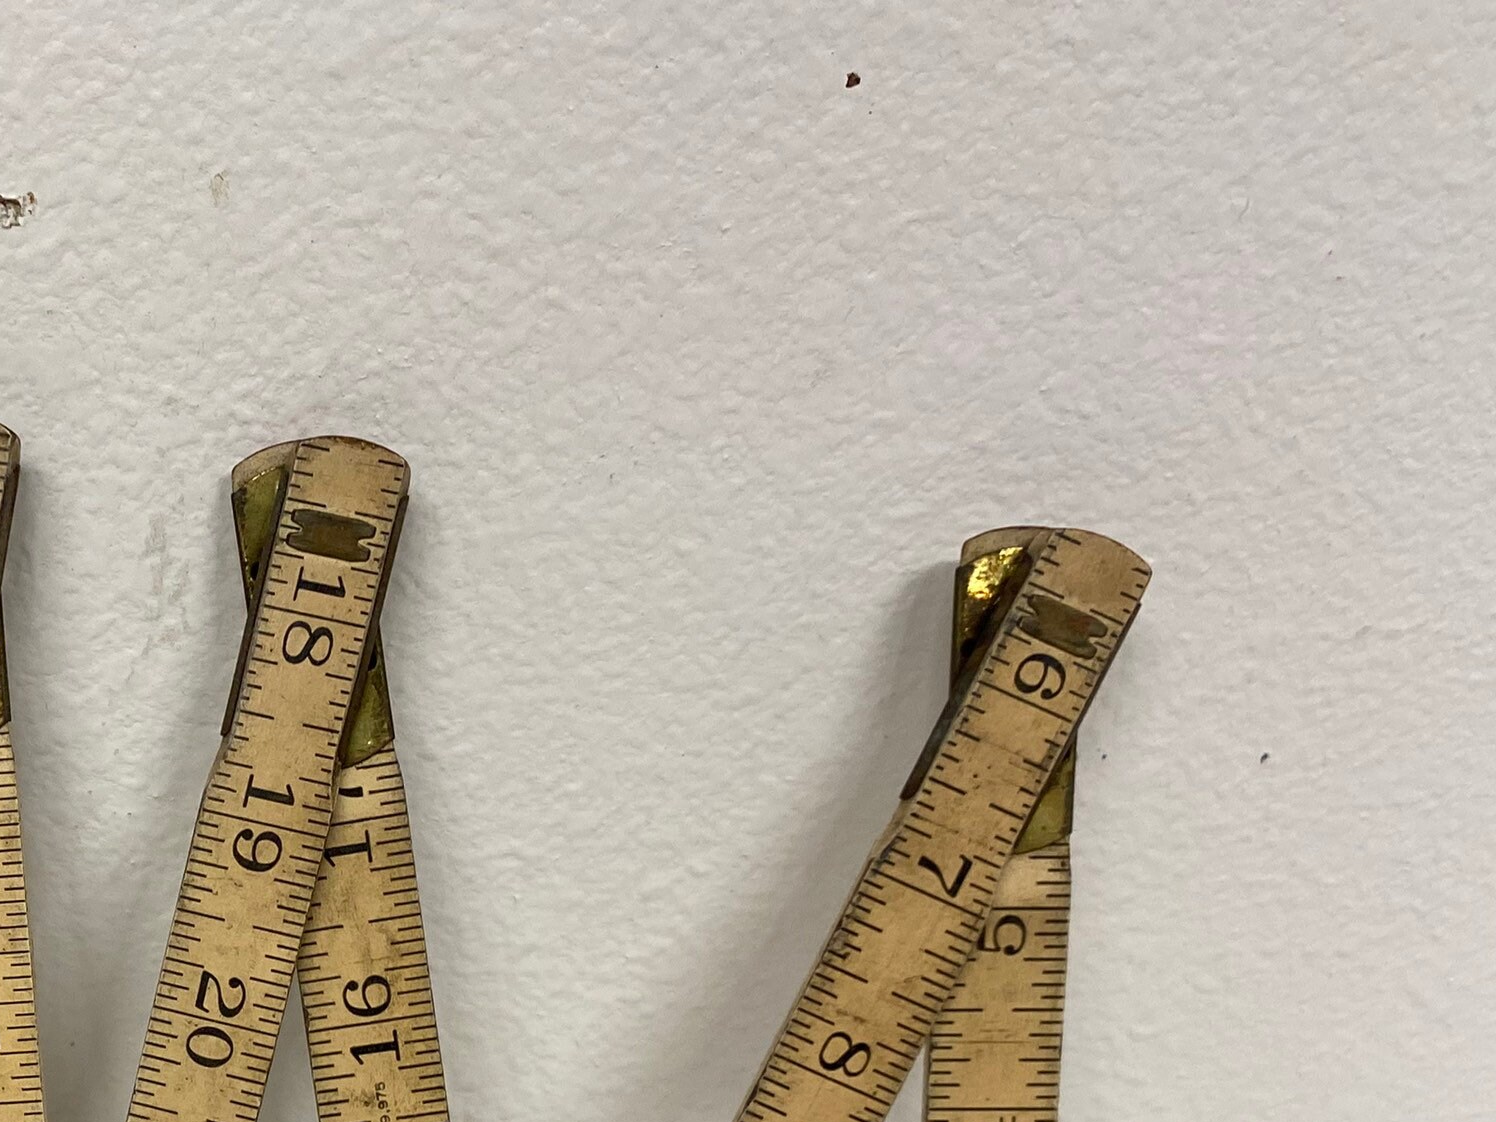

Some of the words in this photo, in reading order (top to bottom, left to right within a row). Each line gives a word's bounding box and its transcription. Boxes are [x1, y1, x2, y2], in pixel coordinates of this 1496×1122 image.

[282, 566, 346, 667] 18
[1013, 652, 1067, 700] 6
[232, 773, 295, 874] 19
[917, 854, 973, 899] 7
[976, 914, 1027, 956] 5
[185, 970, 246, 1068] 20
[342, 974, 401, 1066] 16
[818, 1031, 872, 1077] 8
